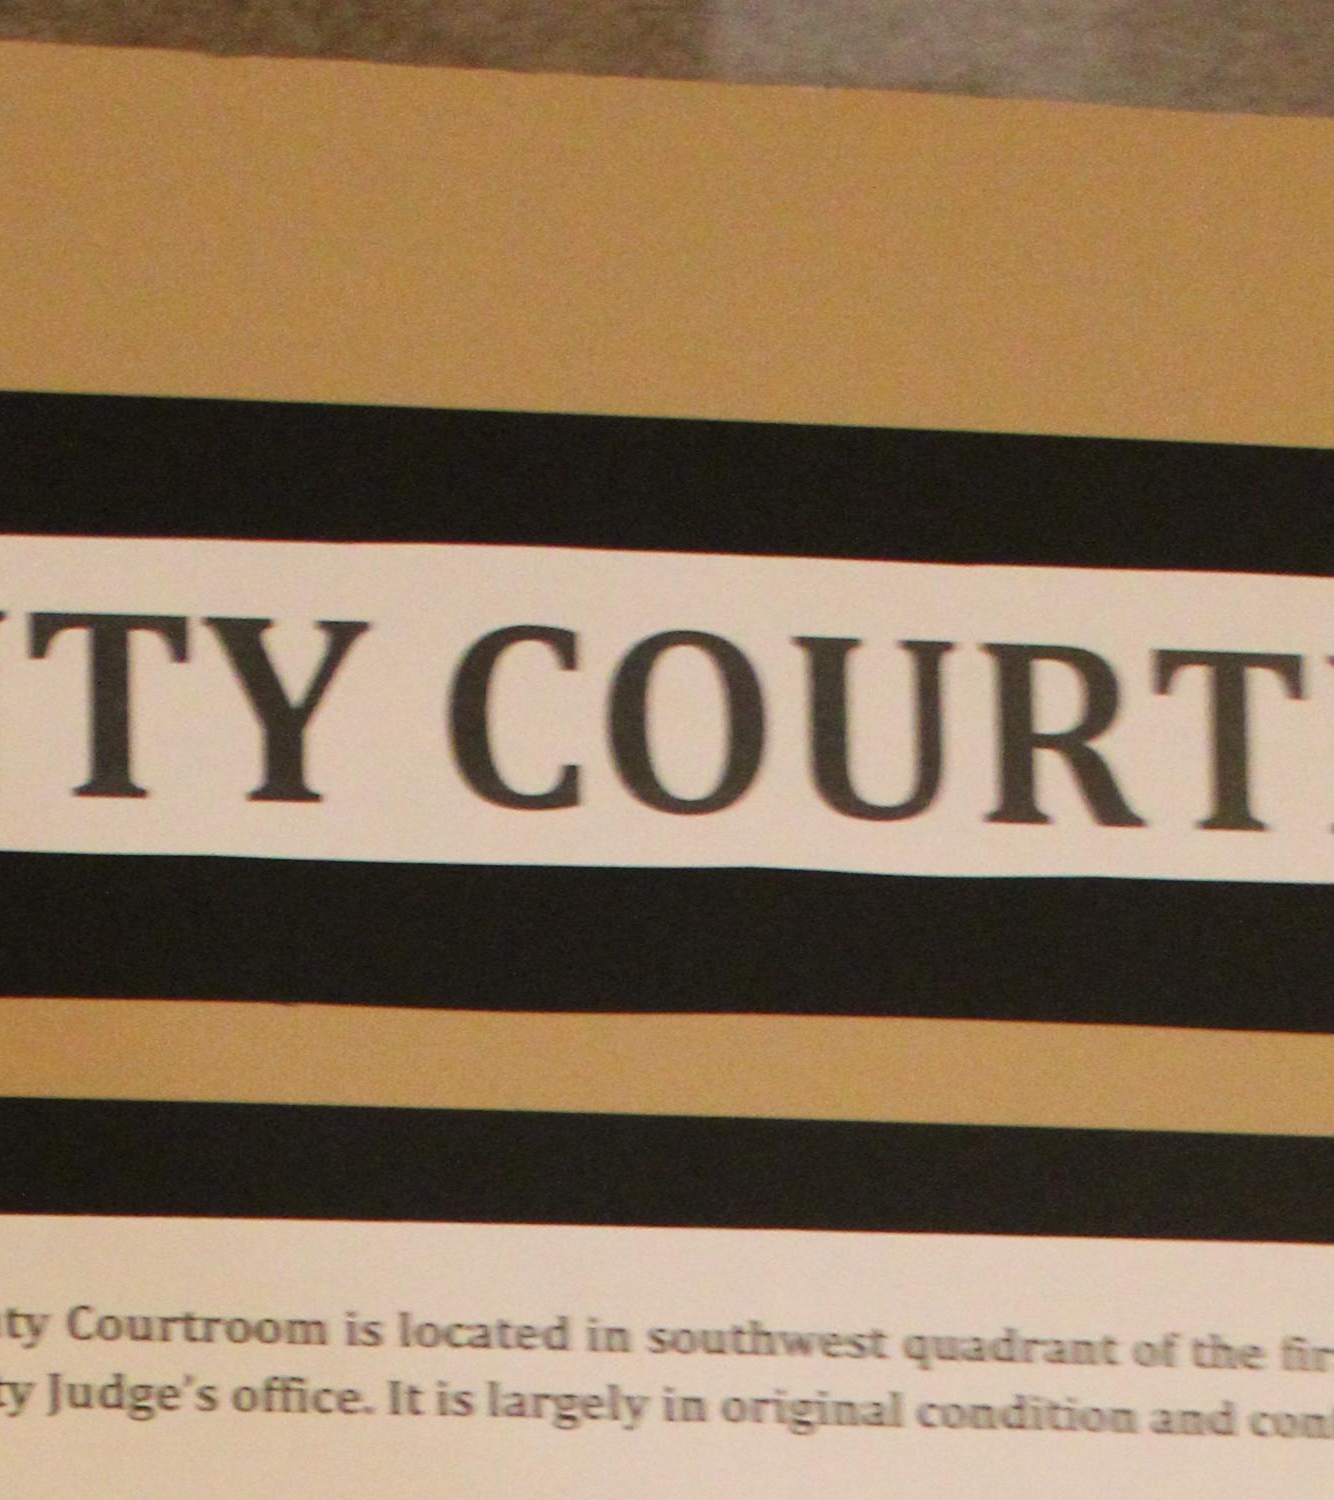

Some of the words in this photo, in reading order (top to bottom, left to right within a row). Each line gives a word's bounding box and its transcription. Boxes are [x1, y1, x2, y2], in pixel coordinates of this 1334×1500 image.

[65, 1303, 330, 1347] Courtroom
[345, 1309, 385, 1349] is
[397, 1309, 571, 1353] located
[586, 1316, 632, 1354] in
[646, 1319, 889, 1361] southwest
[901, 1326, 1120, 1371] quadrant
[1131, 1330, 1181, 1369] of
[1190, 1331, 1266, 1372] the
[47, 1370, 220, 1423] Judge's
[230, 1373, 375, 1417] office.
[388, 1378, 425, 1417] It
[436, 1379, 476, 1418] is
[487, 1380, 650, 1432] largely
[662, 1385, 708, 1424] in
[719, 1389, 904, 1437] original
[915, 1392, 1139, 1435] condition
[1149, 1398, 1238, 1438] and
